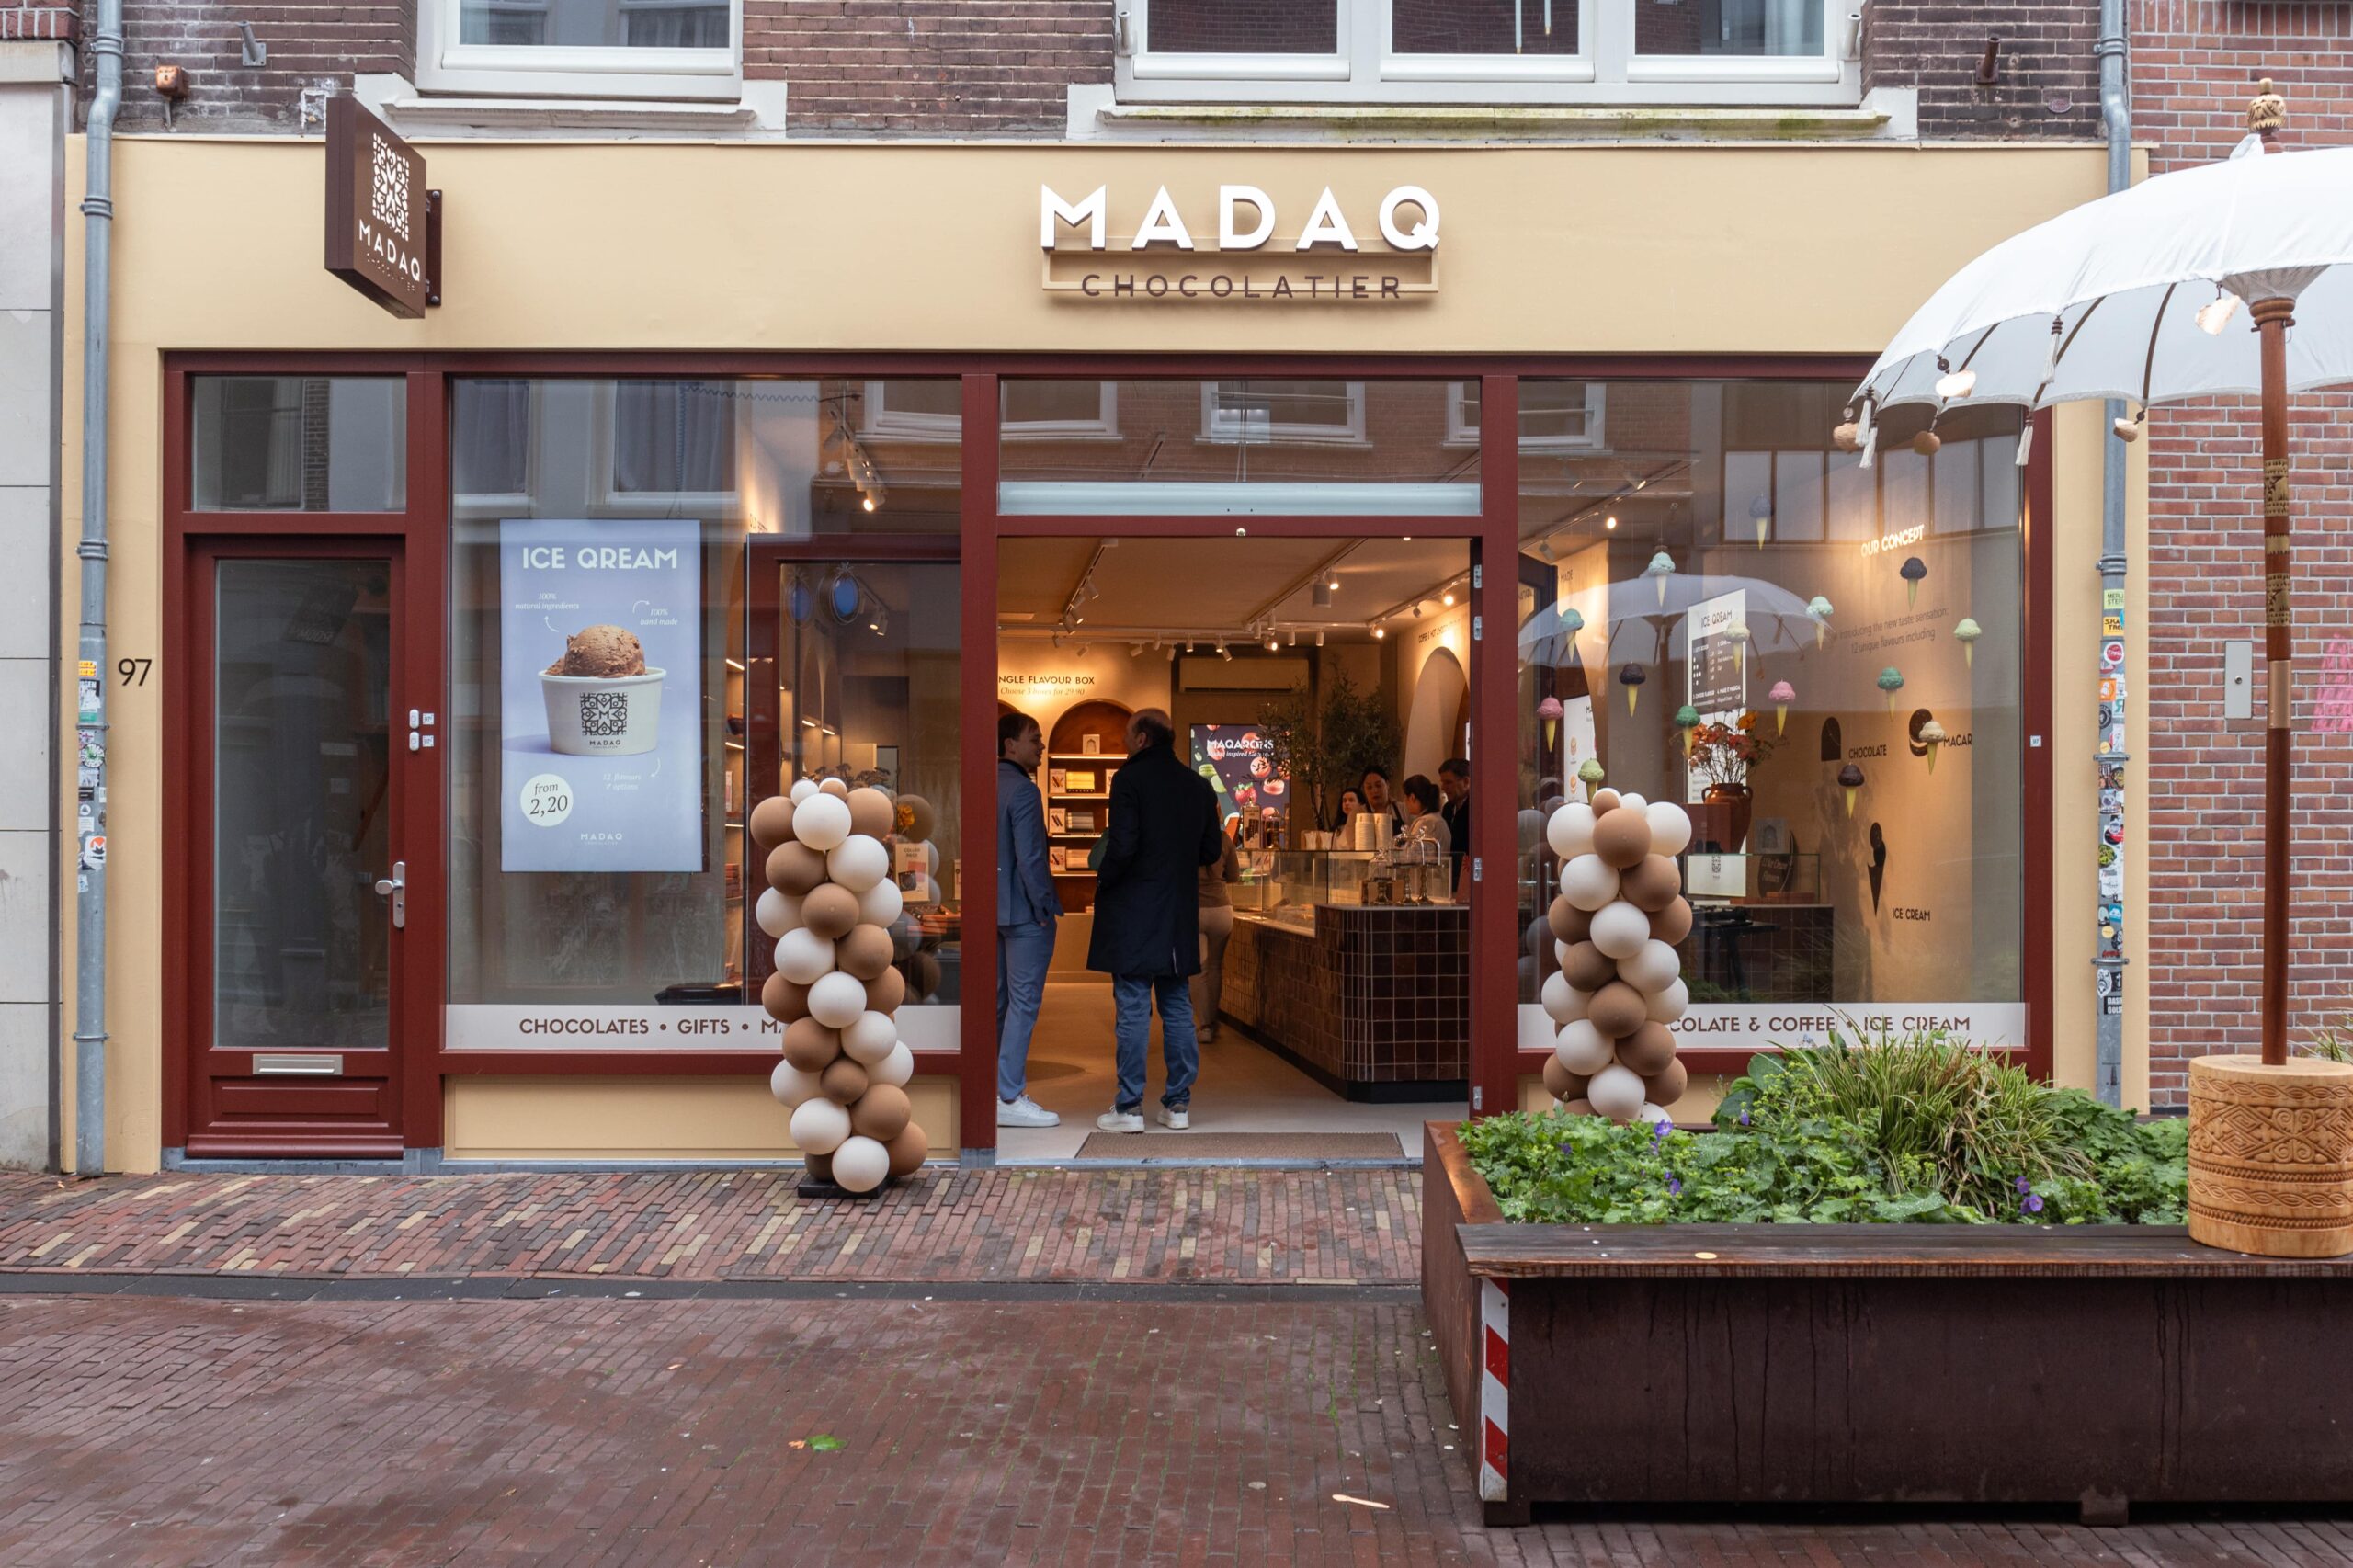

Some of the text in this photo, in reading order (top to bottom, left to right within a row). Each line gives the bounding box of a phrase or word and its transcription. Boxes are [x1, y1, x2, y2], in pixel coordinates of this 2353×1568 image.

[1040, 183, 1440, 251] MADAQ
[359, 219, 420, 282] MADAQ
[1082, 274, 1400, 300] CHOCOLATIER
[1860, 524, 1925, 558] OUR CONCEPT
[523, 547, 677, 569] ICE QREAM
[541, 602, 579, 610] ingredients
[640, 618, 658, 626] hand
[1701, 610, 1733, 628] ICE QREAM
[1873, 622, 1883, 632] the
[1884, 619, 1898, 629] new
[1899, 616, 1914, 627] taste
[1859, 640, 1880, 654] unique
[1881, 634, 1905, 648] flavours
[1906, 627, 1936, 642] including
[118, 658, 152, 687] 97
[1029, 676, 1072, 685] FLAVOUR
[1075, 676, 1095, 685] BOX
[1000, 687, 1025, 695] Choose
[1944, 733, 1972, 747] MACAR
[1848, 744, 1887, 759] CHOCOLATE
[534, 783, 558, 795] from
[529, 794, 568, 817] 2,20
[580, 832, 623, 840] MADAQ
[1893, 907, 1931, 922] ICE CREAM
[519, 1018, 781, 1035] CHOCOLATES GIFTS M
[1748, 1017, 1761, 1032] &
[1768, 1017, 1836, 1031] COFFEE
[1864, 1016, 1893, 1031] ICE
[1902, 1016, 1971, 1031] CREAM
